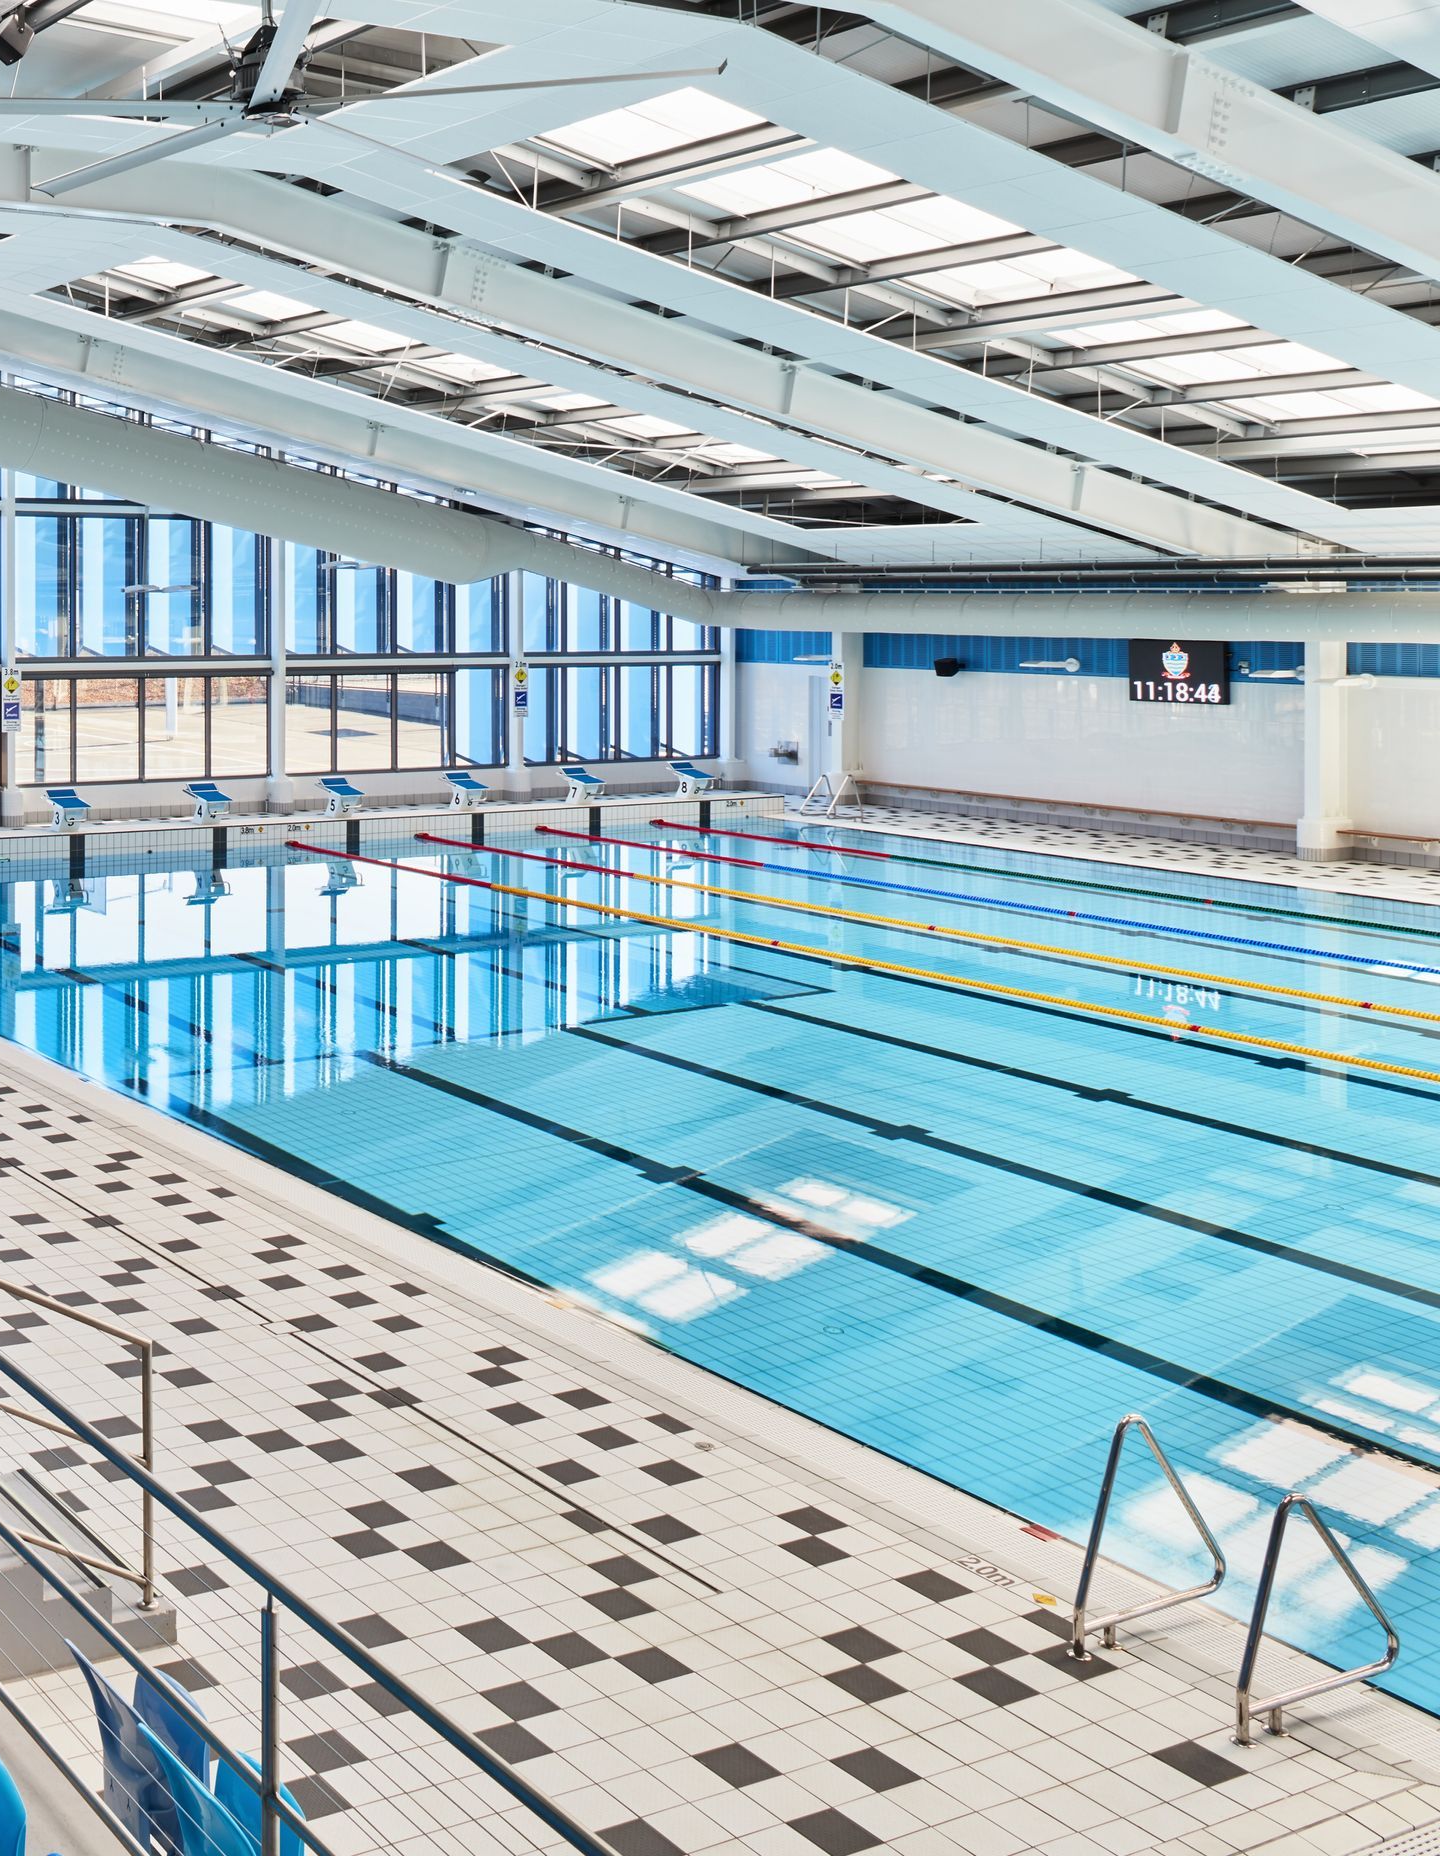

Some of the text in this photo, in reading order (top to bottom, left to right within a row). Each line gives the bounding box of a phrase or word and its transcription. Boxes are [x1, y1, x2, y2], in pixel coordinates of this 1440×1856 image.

[4, 668, 19, 676] 3.8m
[571, 787, 577, 798] 7
[681, 782, 687, 793] 8
[330, 799, 335, 811] 5
[455, 793, 460, 805] 6
[197, 805, 202, 818] 4
[55, 812, 60, 825] 3
[241, 827, 255, 835] 3.8m
[957, 1556, 1015, 1587] 2.0m
